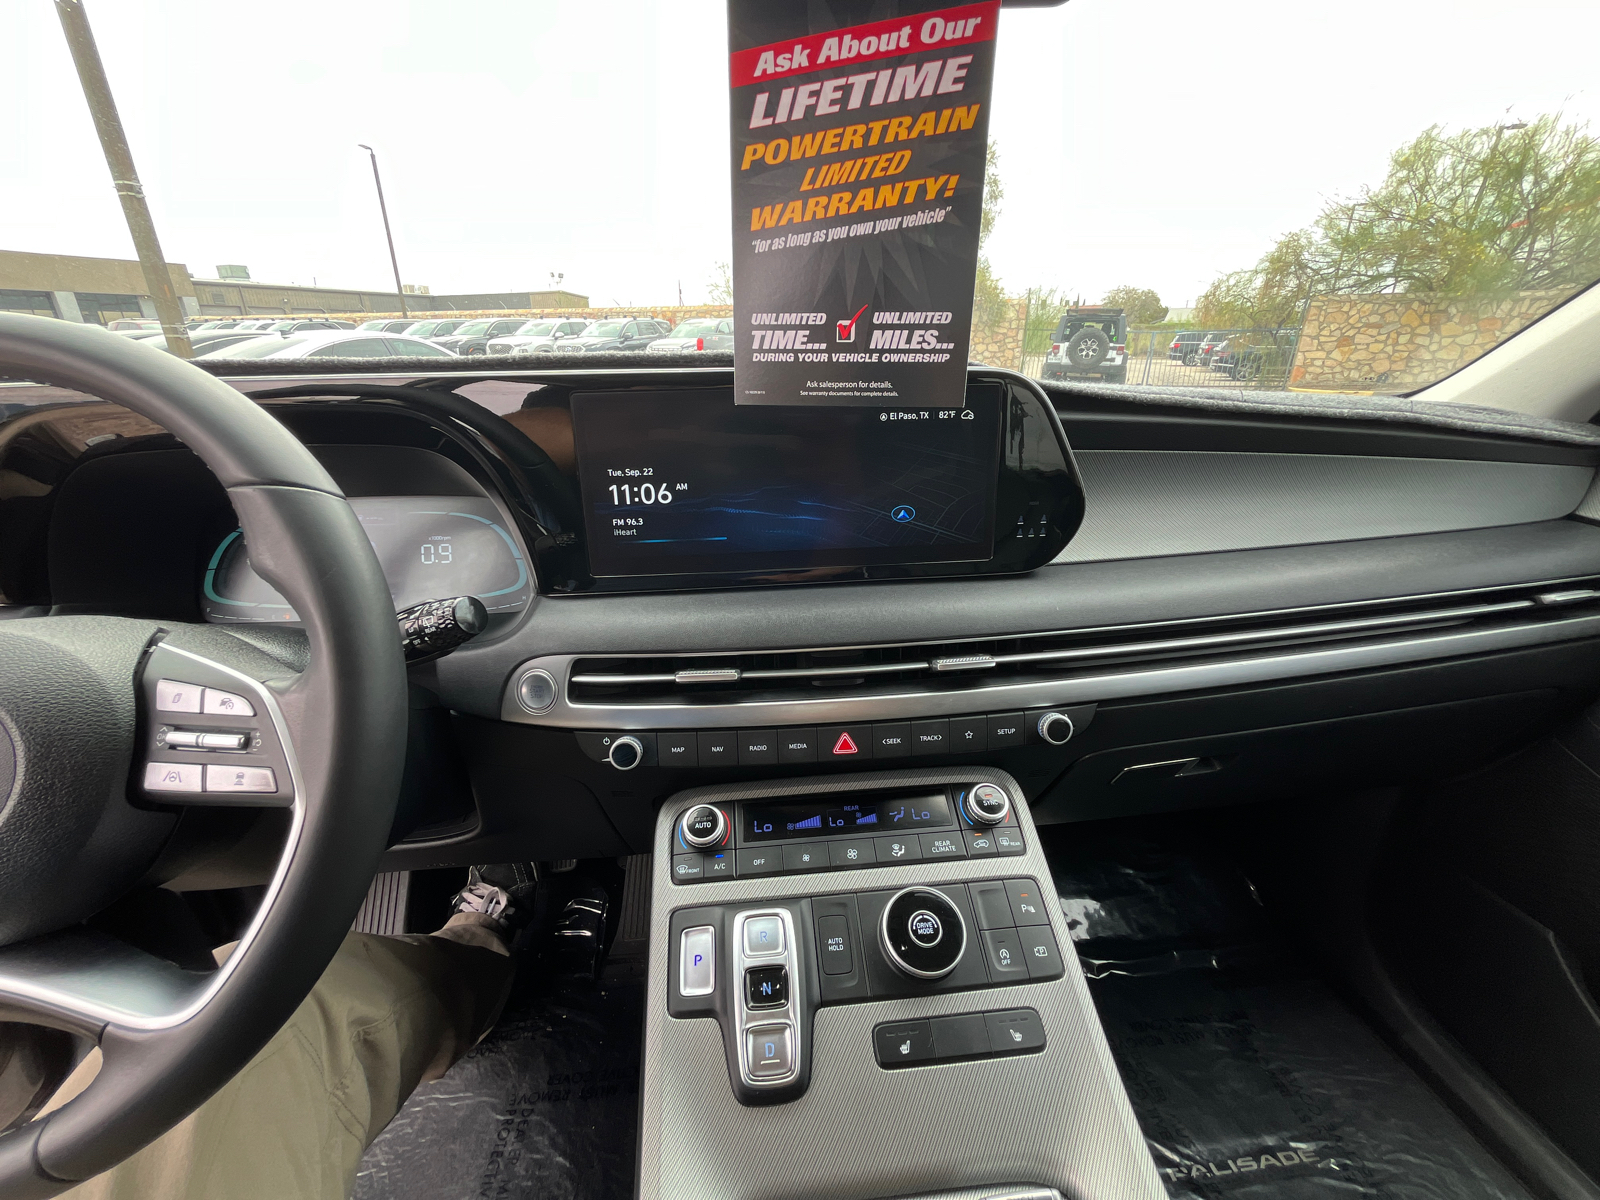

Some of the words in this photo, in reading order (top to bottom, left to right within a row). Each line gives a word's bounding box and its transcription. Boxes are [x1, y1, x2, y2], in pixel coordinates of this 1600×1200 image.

[753, 44, 811, 77] Ask
[816, 25, 912, 64] About
[920, 17, 981, 44] Our
[749, 54, 974, 130] LIFETIME
[740, 103, 981, 170] POWERTRAIN
[799, 149, 912, 192] LIMITED
[750, 174, 960, 232] WARRANTY!
[771, 236, 785, 250] as
[786, 231, 811, 247] long
[812, 229, 826, 243] as
[826, 225, 849, 242] you
[849, 221, 874, 237] own
[874, 216, 902, 235] your
[751, 312, 827, 325] UNLIMITED
[872, 311, 953, 324] UNLIMITED
[751, 330, 827, 350] TIME...
[869, 329, 955, 350] MILES...
[752, 353, 795, 362] DURING
[797, 353, 829, 362] YOUR
[831, 353, 880, 363] VEHICLE
[881, 353, 951, 363] OWNERSHIP
[806, 380, 818, 388] Ask
[819, 380, 858, 389] salesperson
[858, 380, 868, 388] for
[869, 380, 893, 389] details.
[889, 412, 897, 420] El
[898, 412, 918, 420] Paso,
[919, 411, 929, 419] TX
[625, 468, 642, 478] Sep.
[643, 467, 654, 476] 22
[608, 482, 673, 506] 11:06
[675, 483, 688, 491] AM
[626, 518, 644, 526] 96.3
[613, 528, 637, 536] iHeart
[421, 543, 453, 564] 0.9
[997, 728, 1016, 736] SETUP
[789, 742, 807, 750] MEDIA
[694, 821, 712, 829] AUTO
[931, 845, 957, 853] CLIMATE
[713, 862, 726, 870] A/C
[753, 858, 766, 866] OFF
[916, 921, 934, 929] DRIVE
[917, 927, 935, 935] MODE
[759, 931, 768, 943] R
[827, 937, 843, 945] AUTO
[828, 944, 844, 952] HOLD
[693, 954, 703, 967] P
[1001, 958, 1011, 966] OFF
[762, 982, 772, 996] N
[765, 1042, 775, 1057] D
[1166, 1149, 1321, 1182] PALISADE
